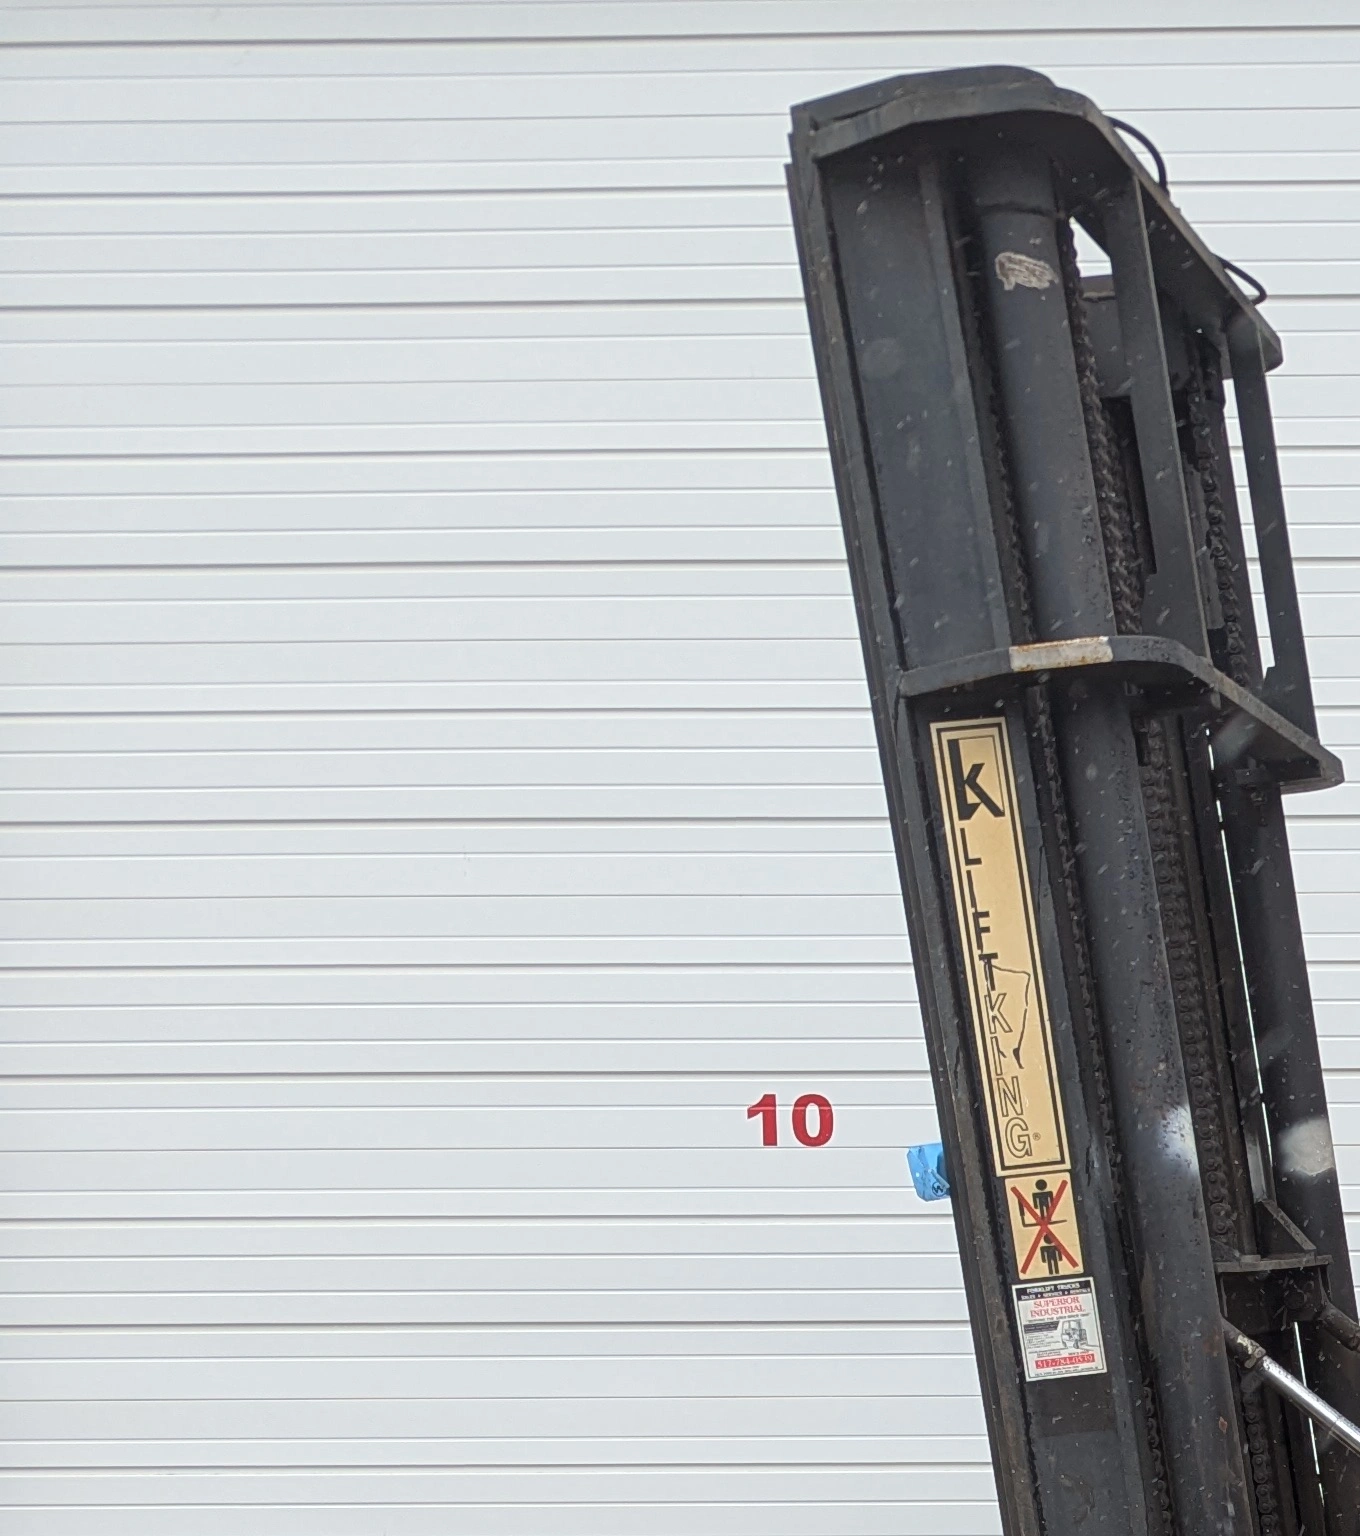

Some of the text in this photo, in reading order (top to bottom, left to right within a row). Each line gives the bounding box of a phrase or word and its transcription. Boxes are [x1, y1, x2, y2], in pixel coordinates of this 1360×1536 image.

[747, 1093, 834, 1147] 10
[1033, 1296, 1080, 1308] SUPERIOR
[1030, 1305, 1084, 1317] INDUSTRIAL
